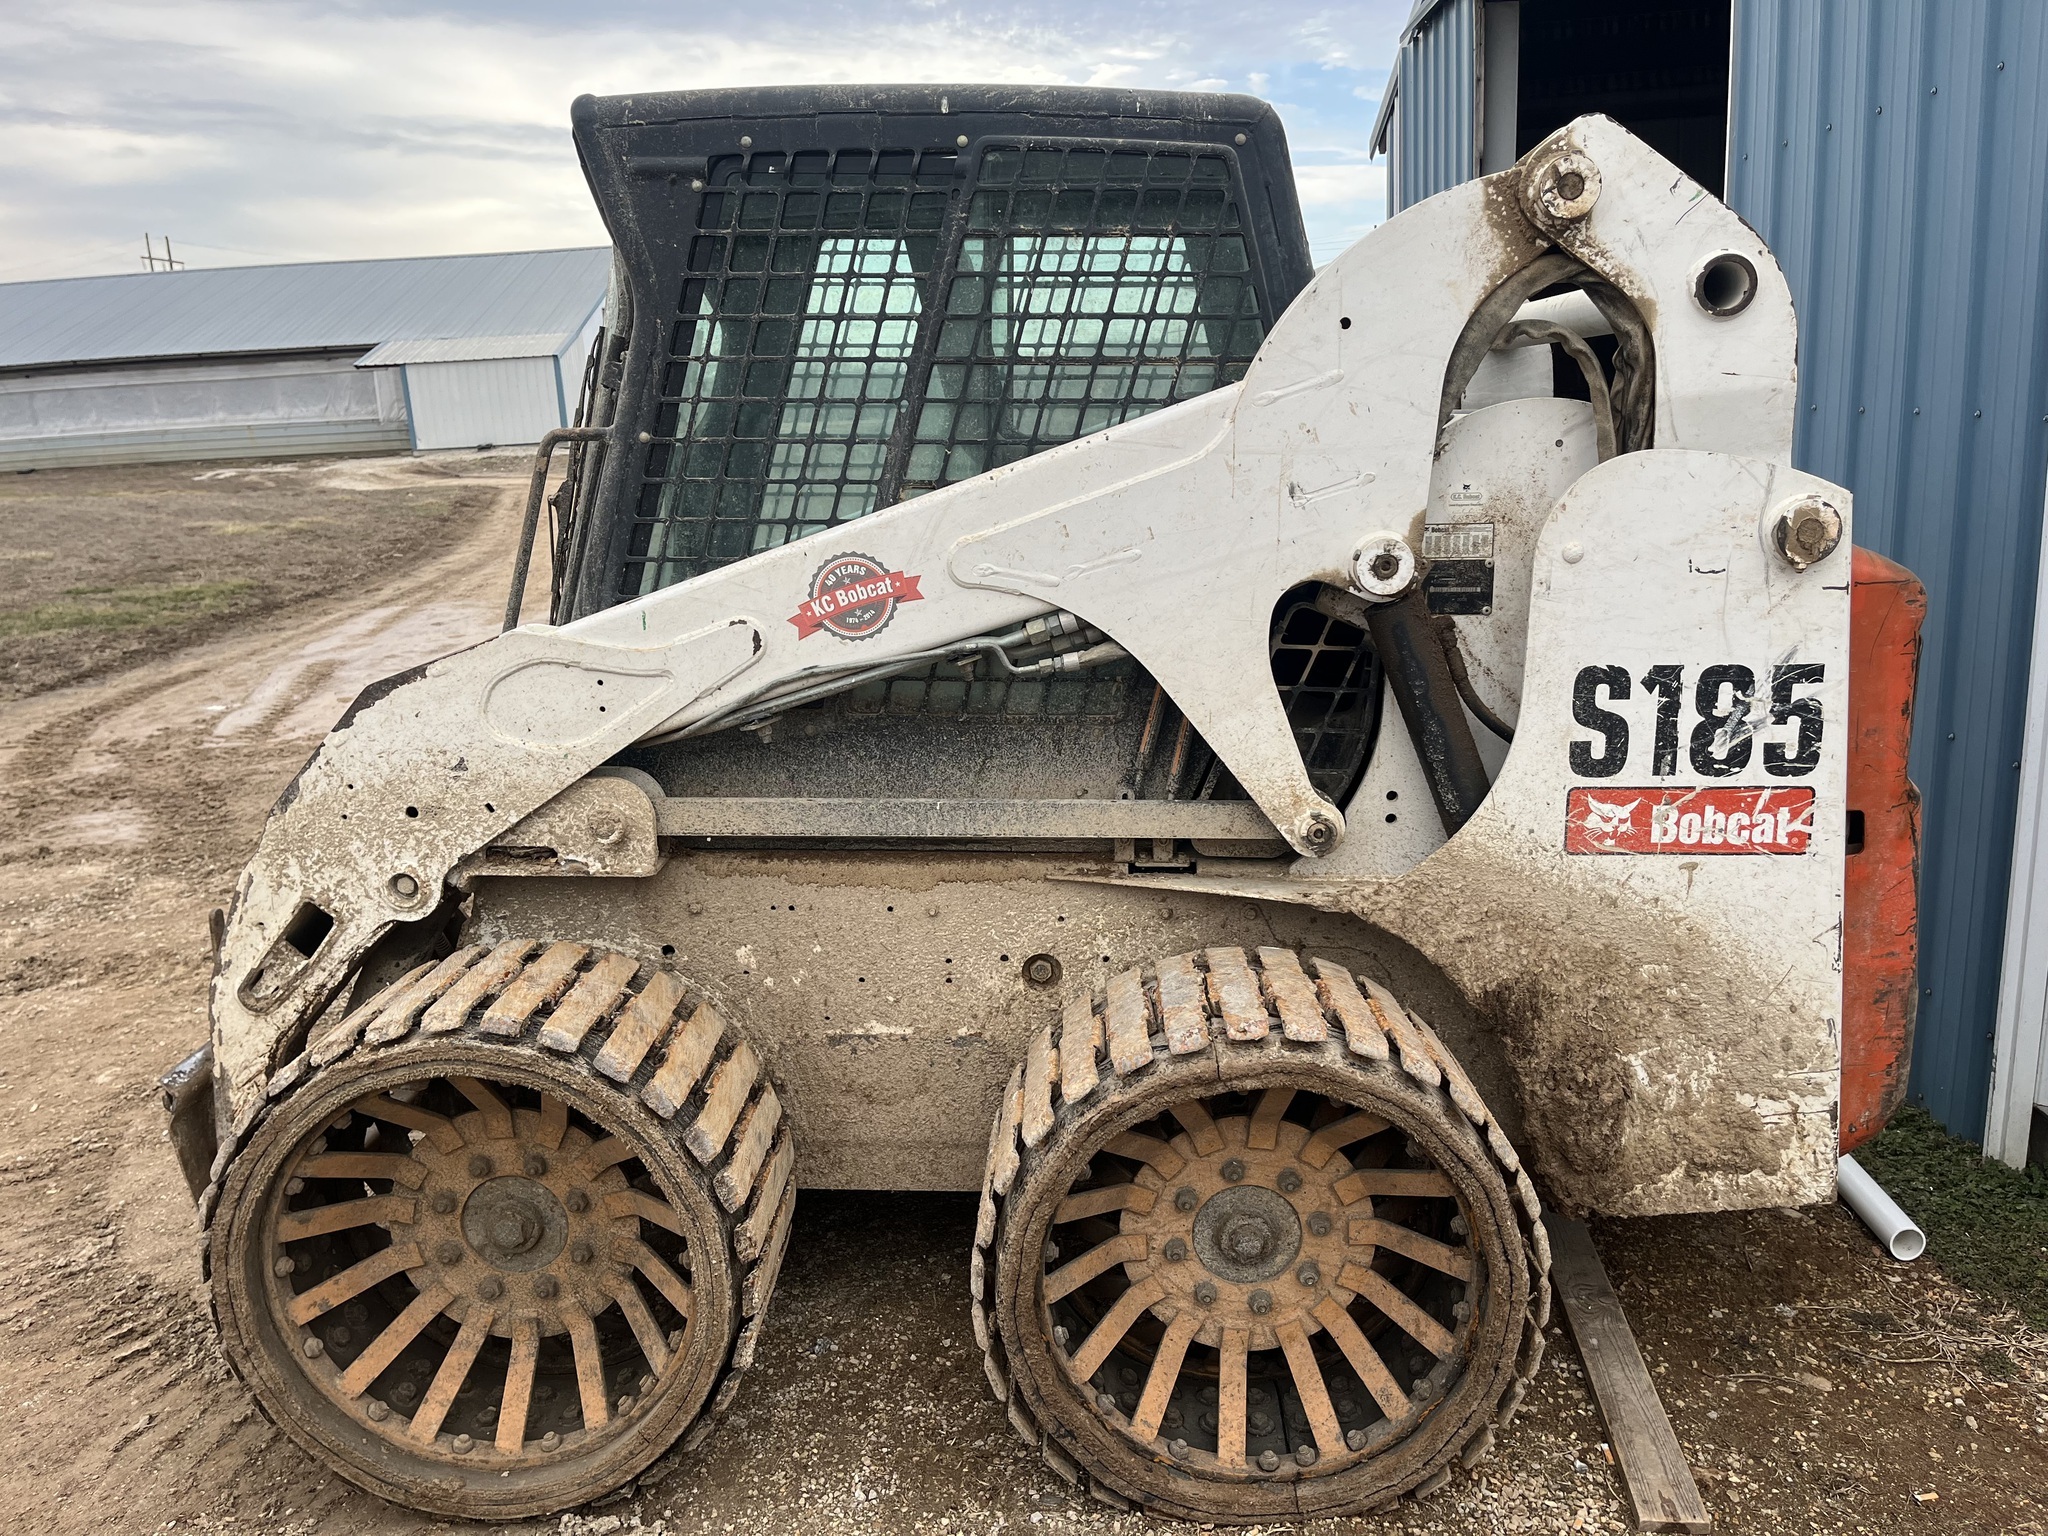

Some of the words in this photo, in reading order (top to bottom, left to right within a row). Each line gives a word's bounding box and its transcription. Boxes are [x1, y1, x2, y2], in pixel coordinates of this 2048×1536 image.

[824, 573, 837, 587] 40
[835, 564, 867, 577] YEARS
[810, 595, 836, 618] KC
[835, 576, 894, 608] Bobcat
[1568, 663, 1826, 778] S185
[1650, 804, 1791, 845] Bobcat
